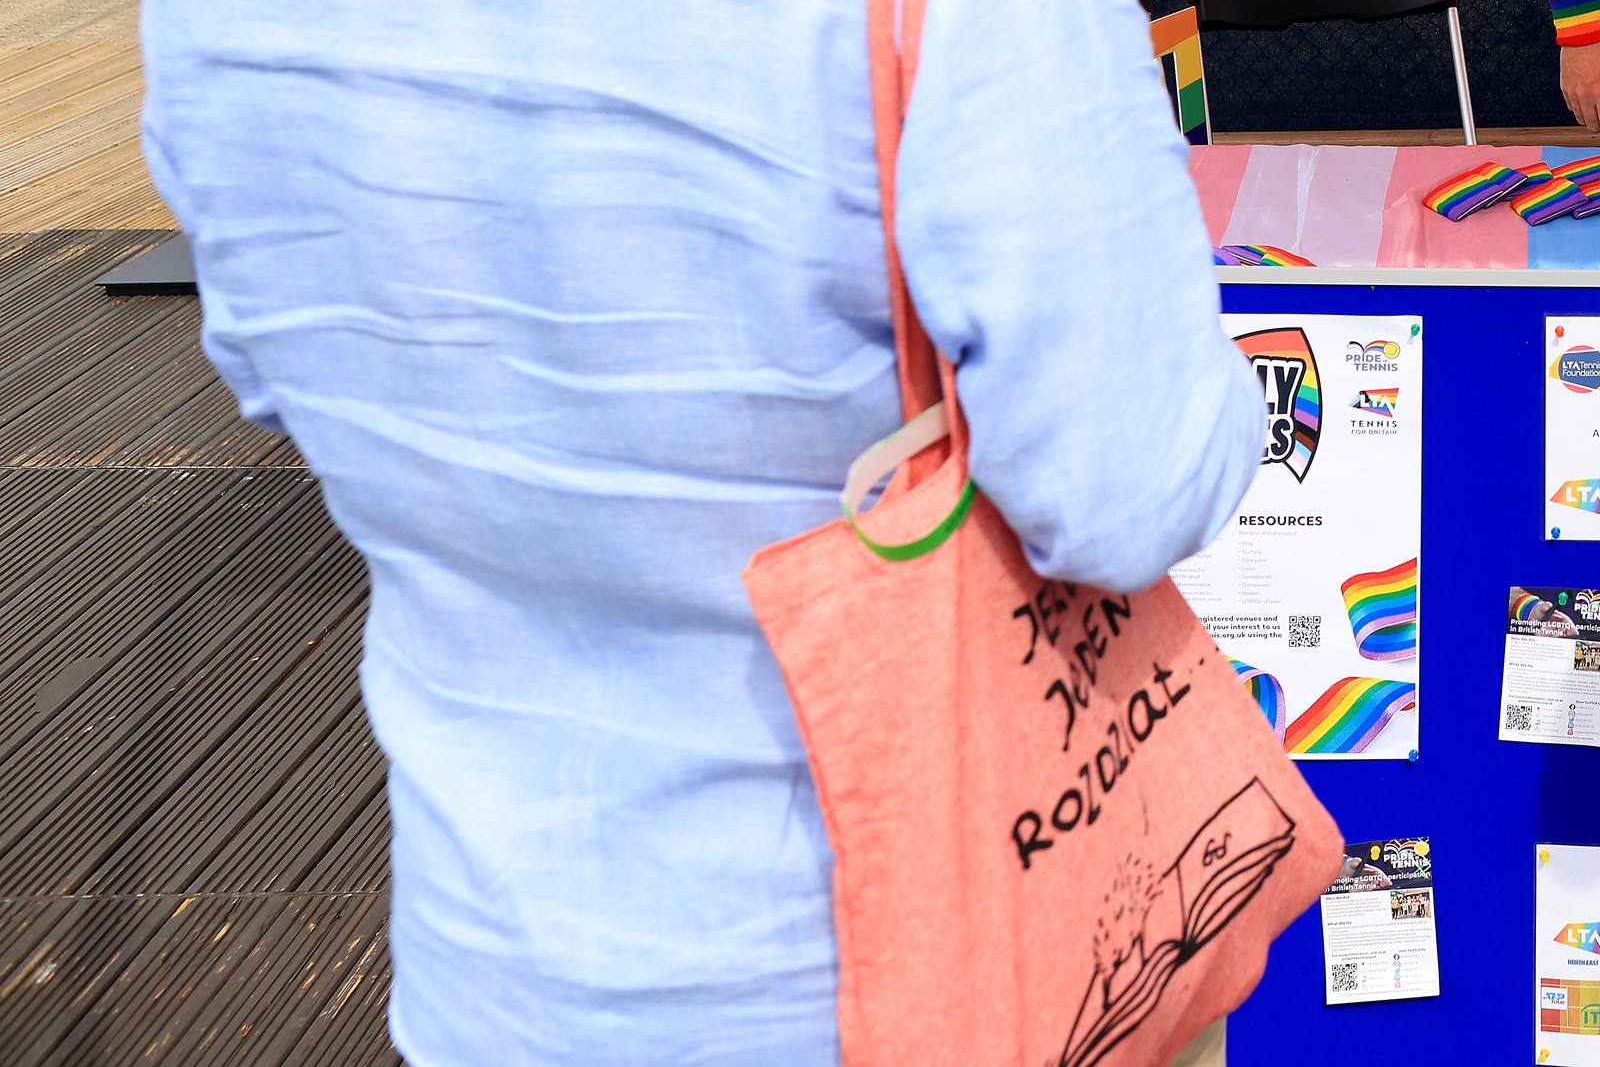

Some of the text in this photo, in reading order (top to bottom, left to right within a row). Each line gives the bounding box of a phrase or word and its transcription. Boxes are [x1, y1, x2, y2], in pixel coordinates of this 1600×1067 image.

[1346, 354, 1382, 363] PRIDE
[1354, 363, 1399, 372] TENNIS
[1562, 361, 1580, 370] LTA
[1360, 394, 1395, 409] LTA
[1351, 420, 1398, 428] TENNIS
[1239, 516, 1323, 526] RESOURCES
[1199, 615, 1234, 623] egistered
[1510, 619, 1546, 627] Promoting
[1518, 626, 1540, 634] British
[1541, 628, 1564, 636] Tennis
[1384, 854, 1414, 862] PRIDE
[1391, 860, 1430, 869] TENNIS
[1388, 871, 1431, 880] participation
[1332, 884, 1354, 892] British
[1543, 992, 1565, 1000] ATP
